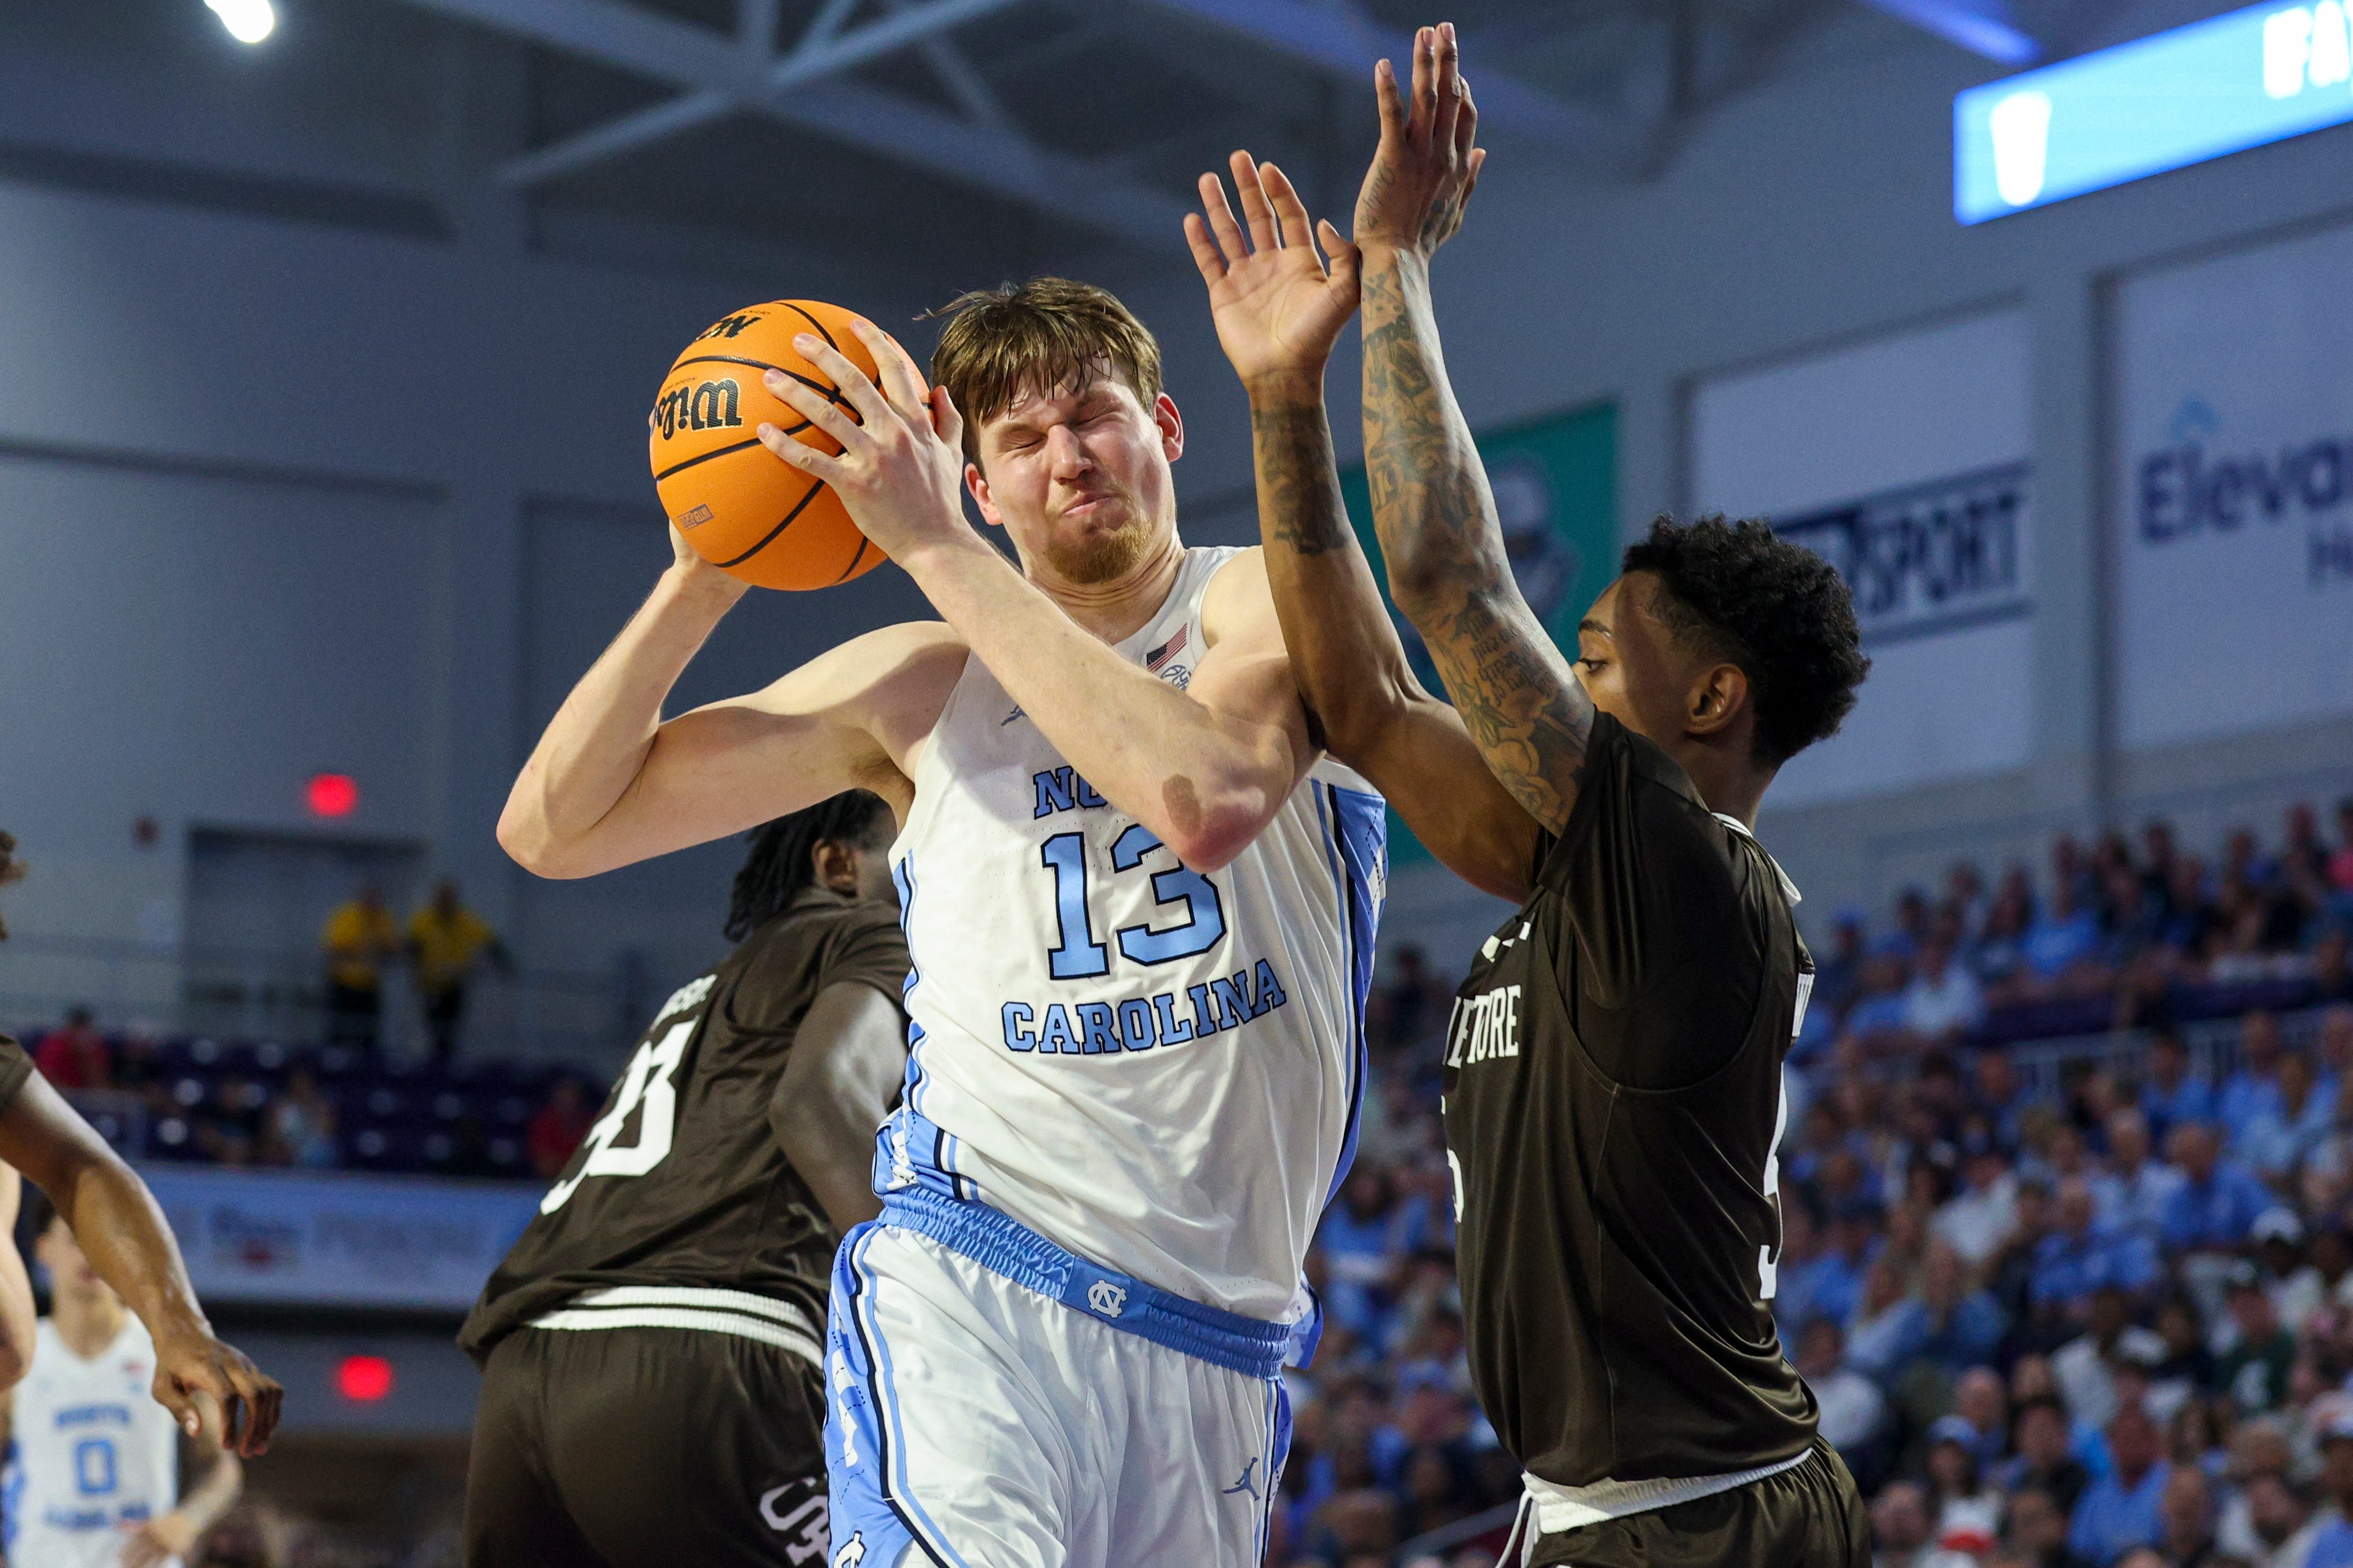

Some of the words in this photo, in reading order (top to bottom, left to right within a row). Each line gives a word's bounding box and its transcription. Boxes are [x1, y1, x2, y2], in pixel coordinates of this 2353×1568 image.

[1041, 823, 1227, 980] 13
[1001, 957, 1287, 1055] CAROLINA
[75, 1438, 117, 1494] 0
